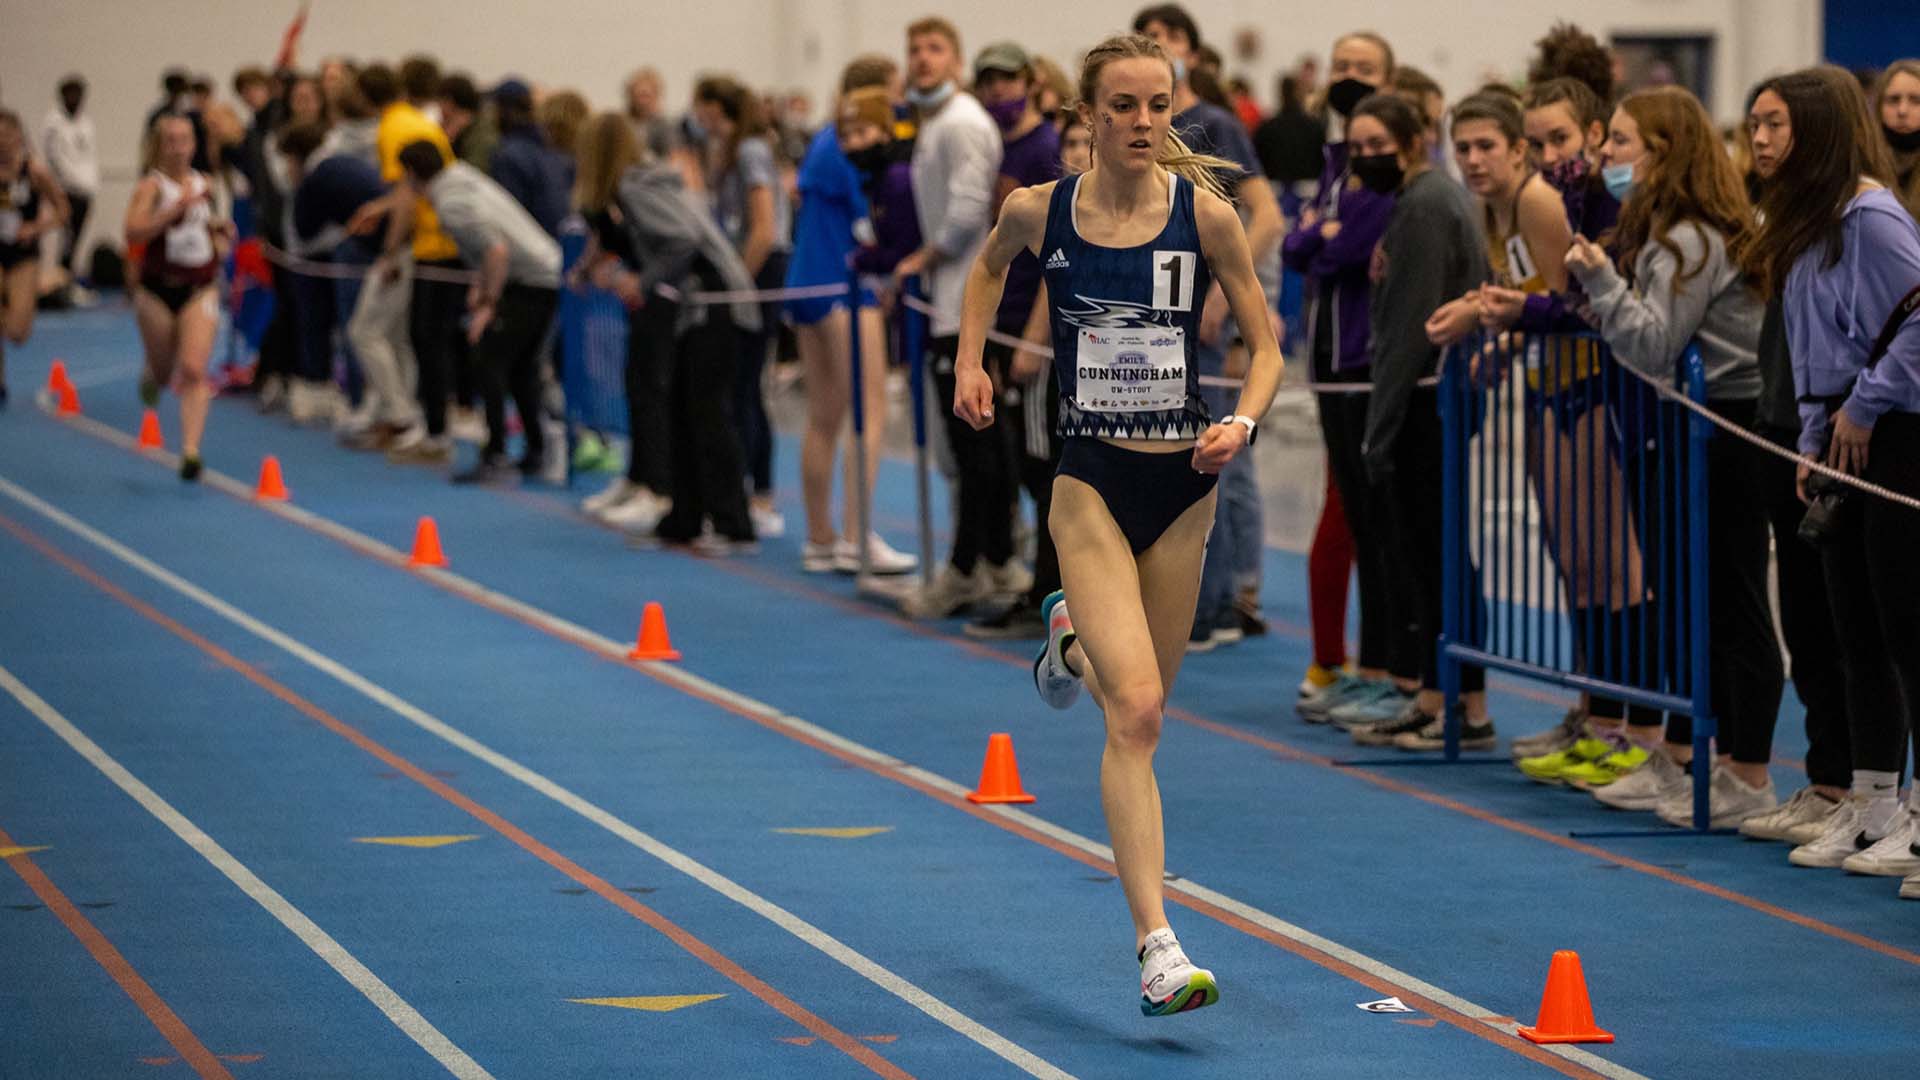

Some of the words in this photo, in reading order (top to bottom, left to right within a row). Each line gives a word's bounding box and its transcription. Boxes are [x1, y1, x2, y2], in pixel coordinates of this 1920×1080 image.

[1046, 260, 1070, 269] adidas
[1512, 241, 1526, 277] 1
[1160, 256, 1182, 307] 1
[1079, 367, 1183, 380] CUNNINGHAM
